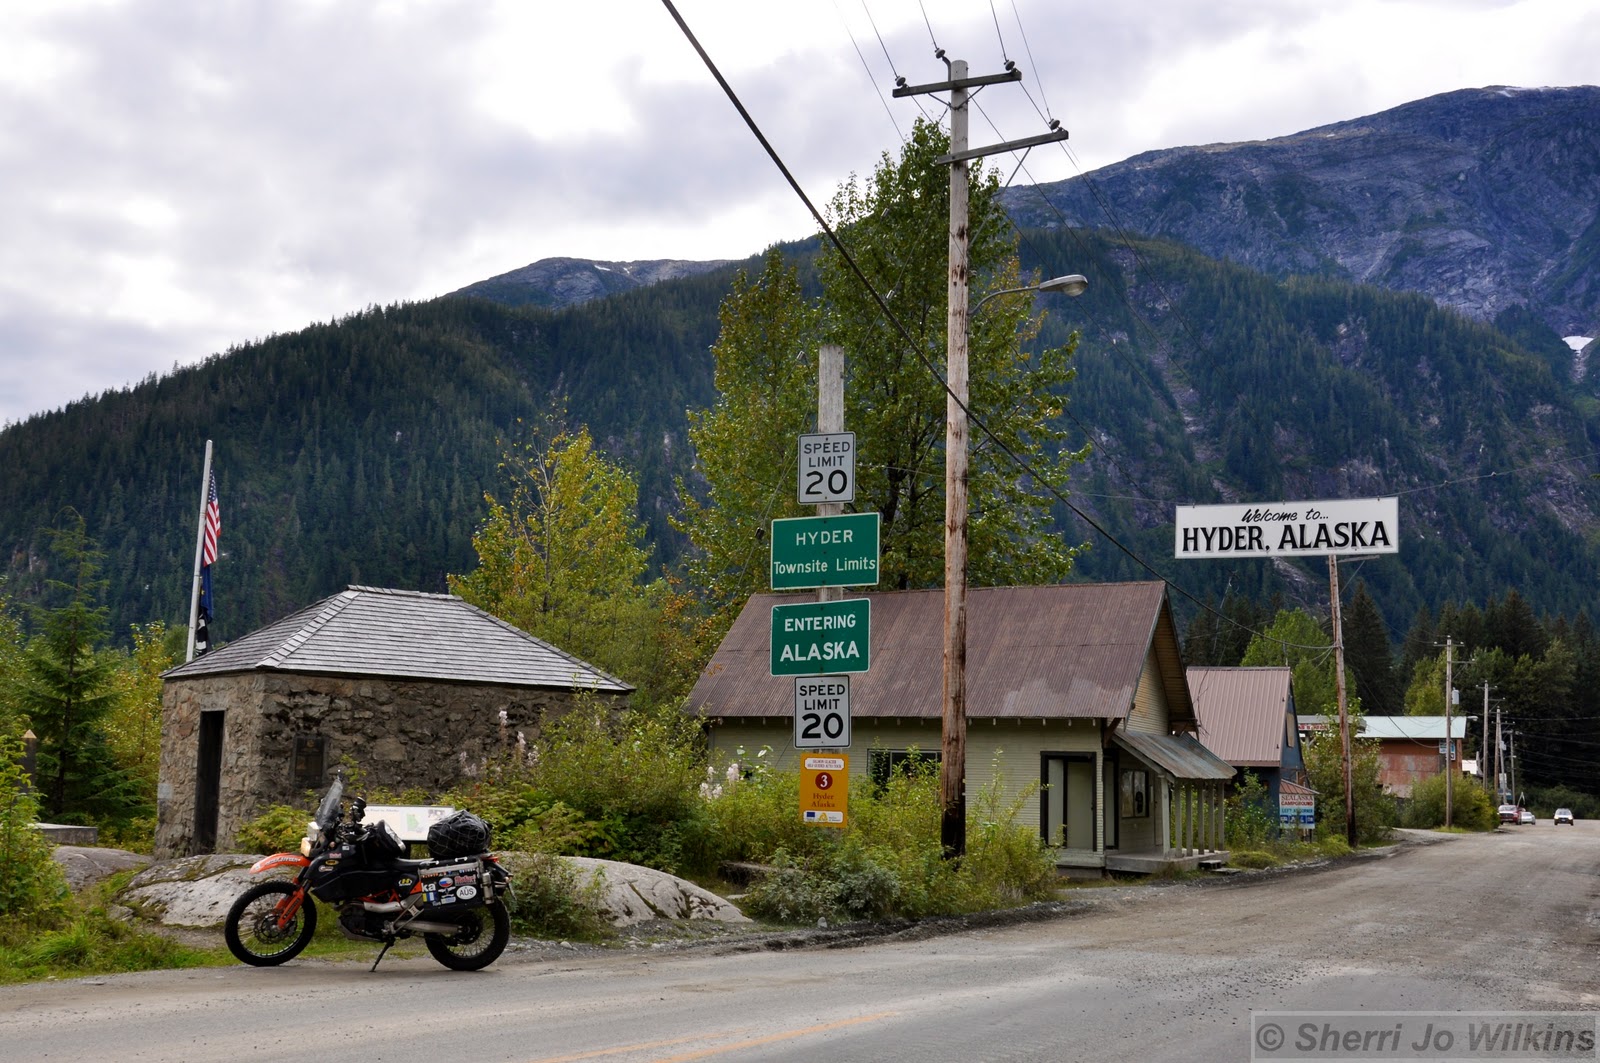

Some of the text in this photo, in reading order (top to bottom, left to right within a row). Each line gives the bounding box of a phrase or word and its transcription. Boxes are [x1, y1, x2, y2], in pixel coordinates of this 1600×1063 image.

[803, 441, 850, 454] SPEED
[808, 455, 845, 468] LIMIT
[805, 469, 848, 495] 20
[1241, 507, 1329, 523] Welcome to...
[795, 529, 854, 546] HYDER
[1182, 520, 1391, 552] HYDER, ALASKA
[773, 556, 876, 575] Townsite Limits
[784, 613, 857, 632] ENTERING
[779, 640, 860, 662] ALASKA
[799, 684, 846, 697] SPEED
[804, 698, 841, 711] LIMIT
[801, 712, 844, 739] 20
[820, 774, 828, 788] 3
[812, 793, 834, 801] Hyder
